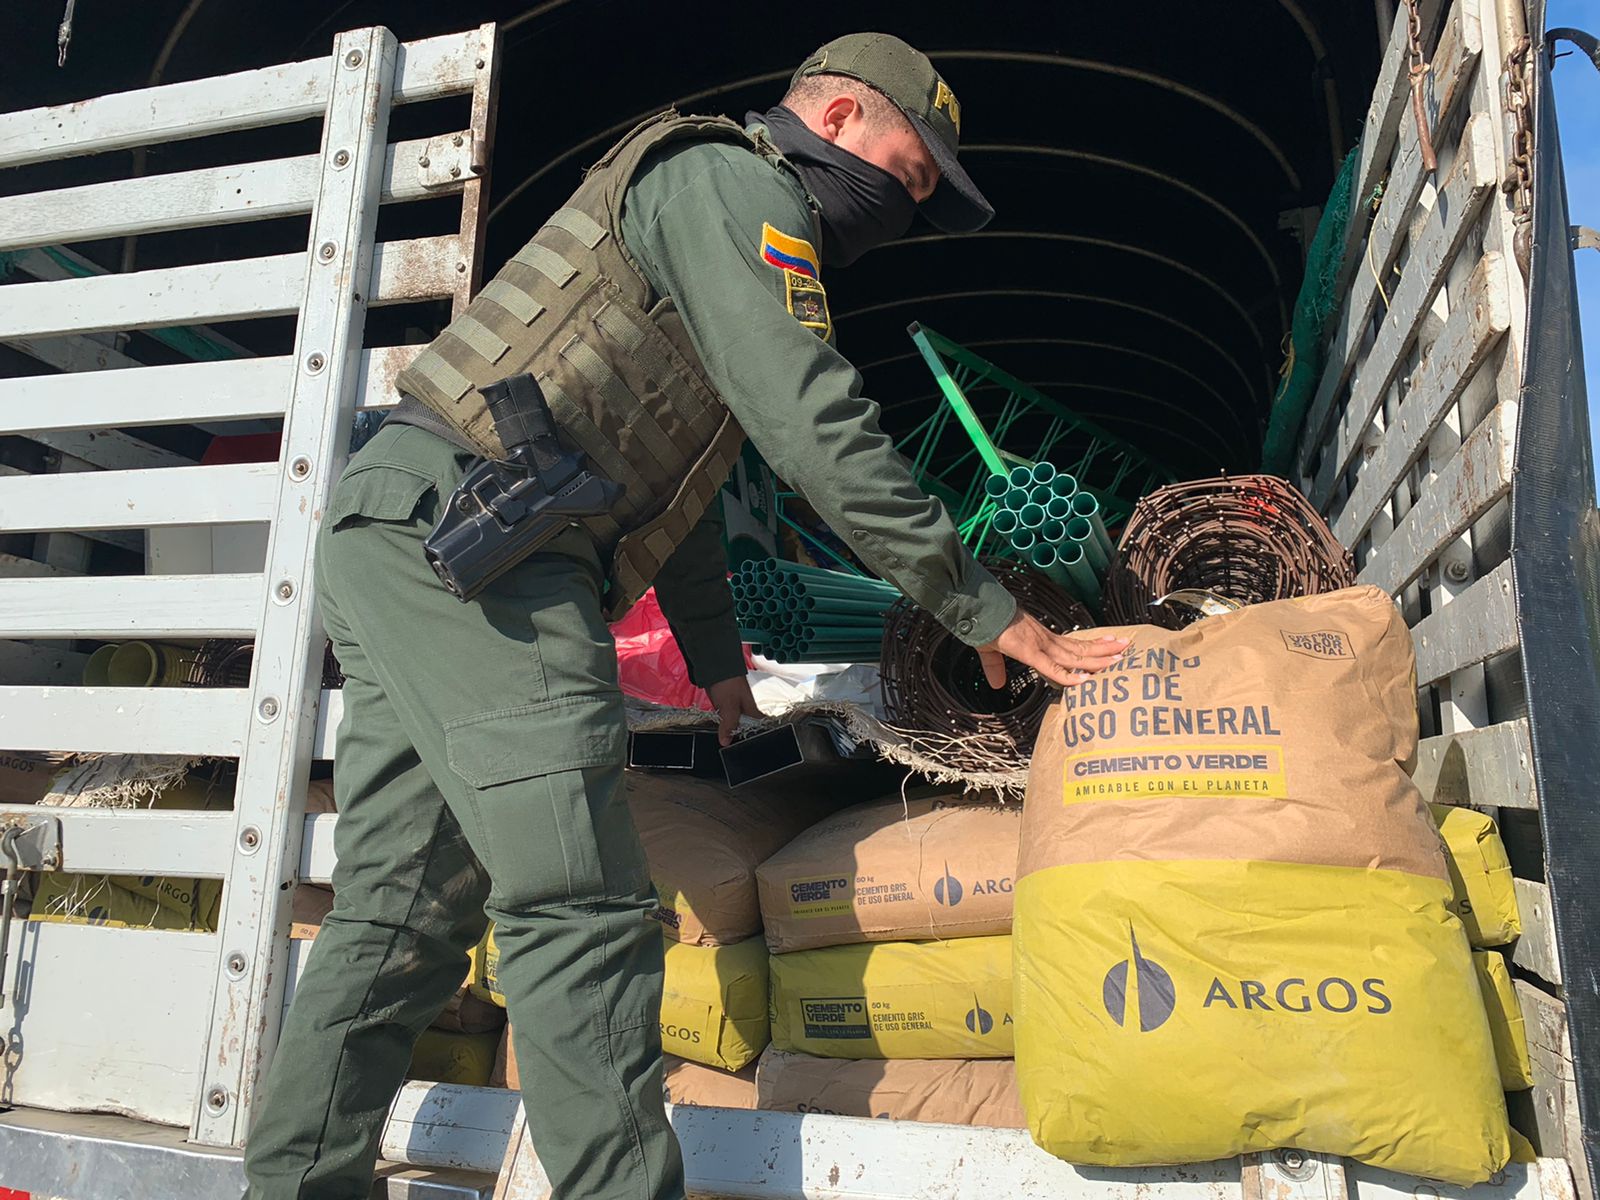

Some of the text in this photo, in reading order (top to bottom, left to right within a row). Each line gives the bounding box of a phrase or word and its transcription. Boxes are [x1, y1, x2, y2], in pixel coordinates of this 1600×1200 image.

[1293, 641, 1346, 656] SOCIAL
[1063, 672, 1183, 712] GRIS DE
[1063, 705, 1282, 748] USO GENERAL
[1073, 754, 1268, 777] CEMENTO VERDE
[1075, 780, 1269, 796] AMIGABLE CON EL PLANETA
[790, 878, 847, 894] CEMENTO
[856, 882, 907, 896] CEMENTO GRIS
[972, 877, 1013, 896] ARG
[156, 881, 193, 907] ARGO
[792, 890, 831, 902] VERDE
[857, 891, 914, 906] DE USO GENERAL
[1203, 976, 1393, 1015] ARGOS
[805, 1003, 862, 1013] CEMENTO
[806, 1013, 846, 1022] VERDE
[873, 1011, 925, 1022] CEMENTO GRIS
[874, 1021, 933, 1031] DE USO GENERAL
